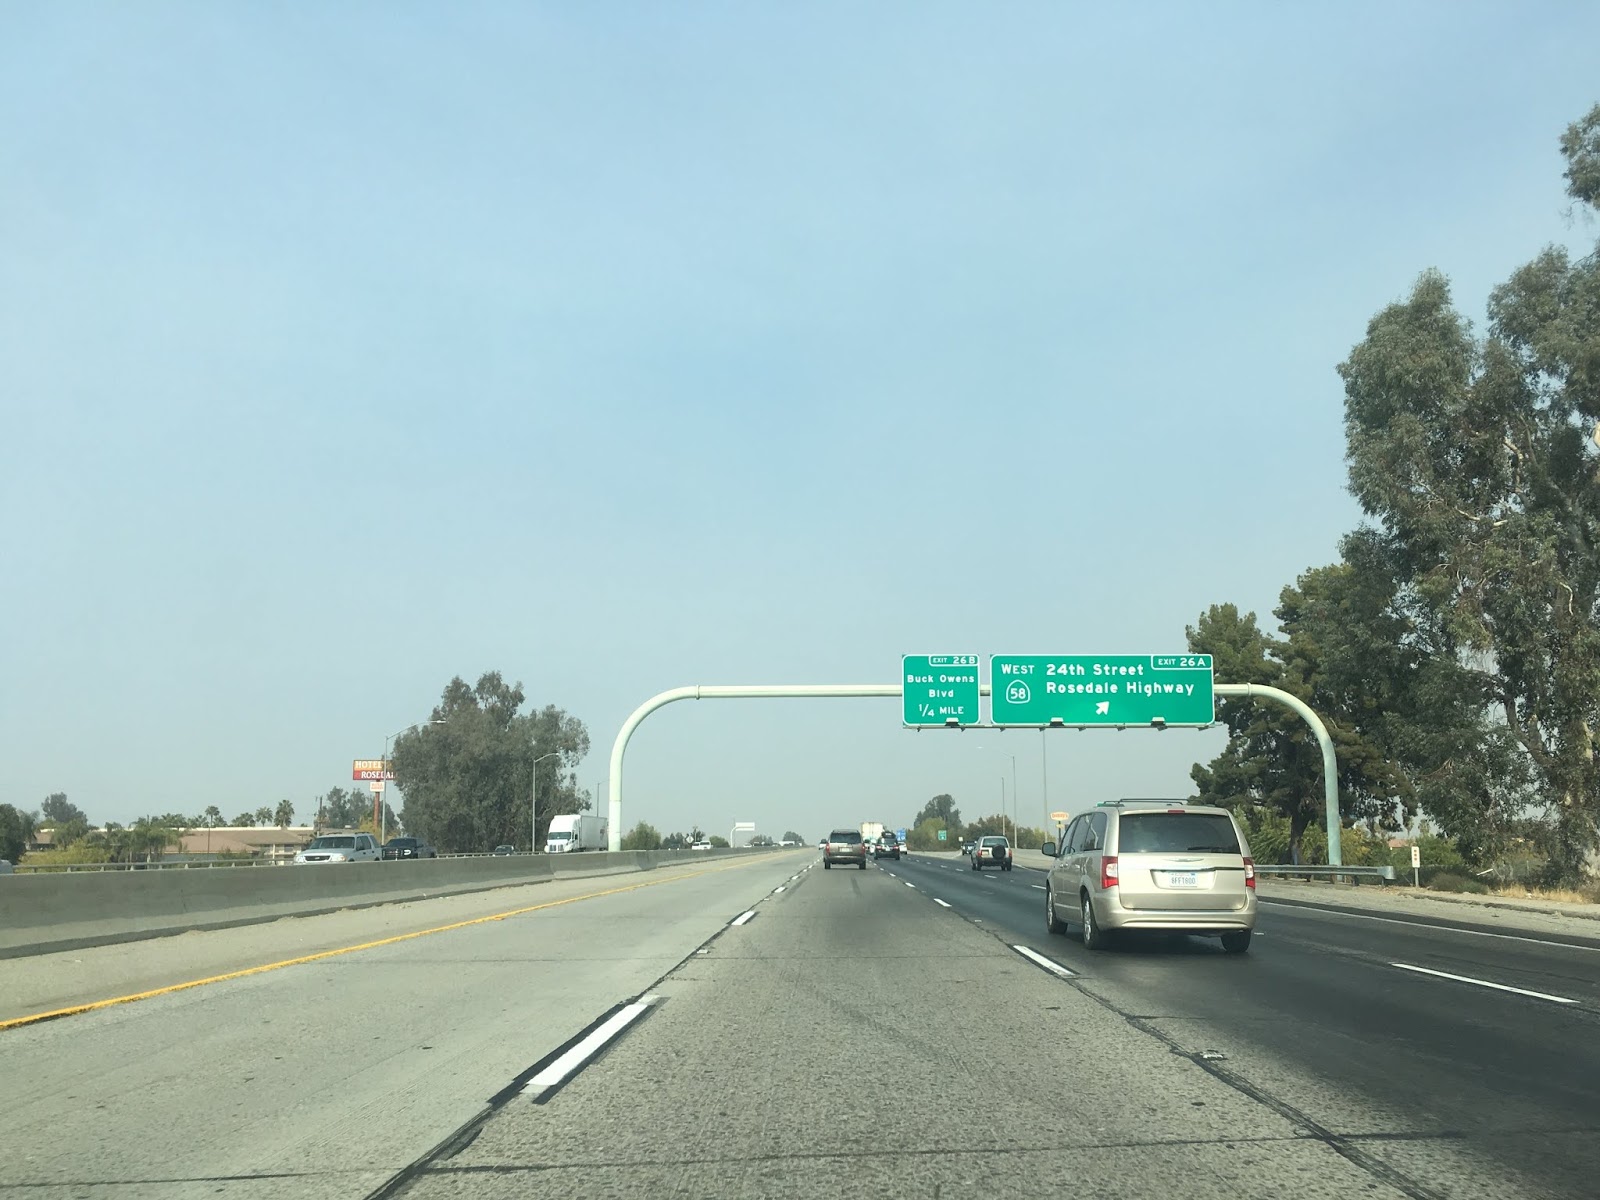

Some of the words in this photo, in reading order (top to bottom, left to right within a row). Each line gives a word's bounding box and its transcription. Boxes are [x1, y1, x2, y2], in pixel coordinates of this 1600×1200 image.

[1158, 658, 1176, 666] EXIT
[1001, 663, 1035, 675] WEST
[1046, 663, 1085, 676] 24th
[1092, 663, 1144, 676] Street
[907, 674, 934, 683] Buck
[939, 674, 975, 683] Owens
[928, 689, 954, 698] Blvd
[1010, 687, 1027, 700] 58
[1046, 681, 1118, 694] Rosedale
[1126, 681, 1194, 697] Highway
[939, 706, 964, 715] MILE
